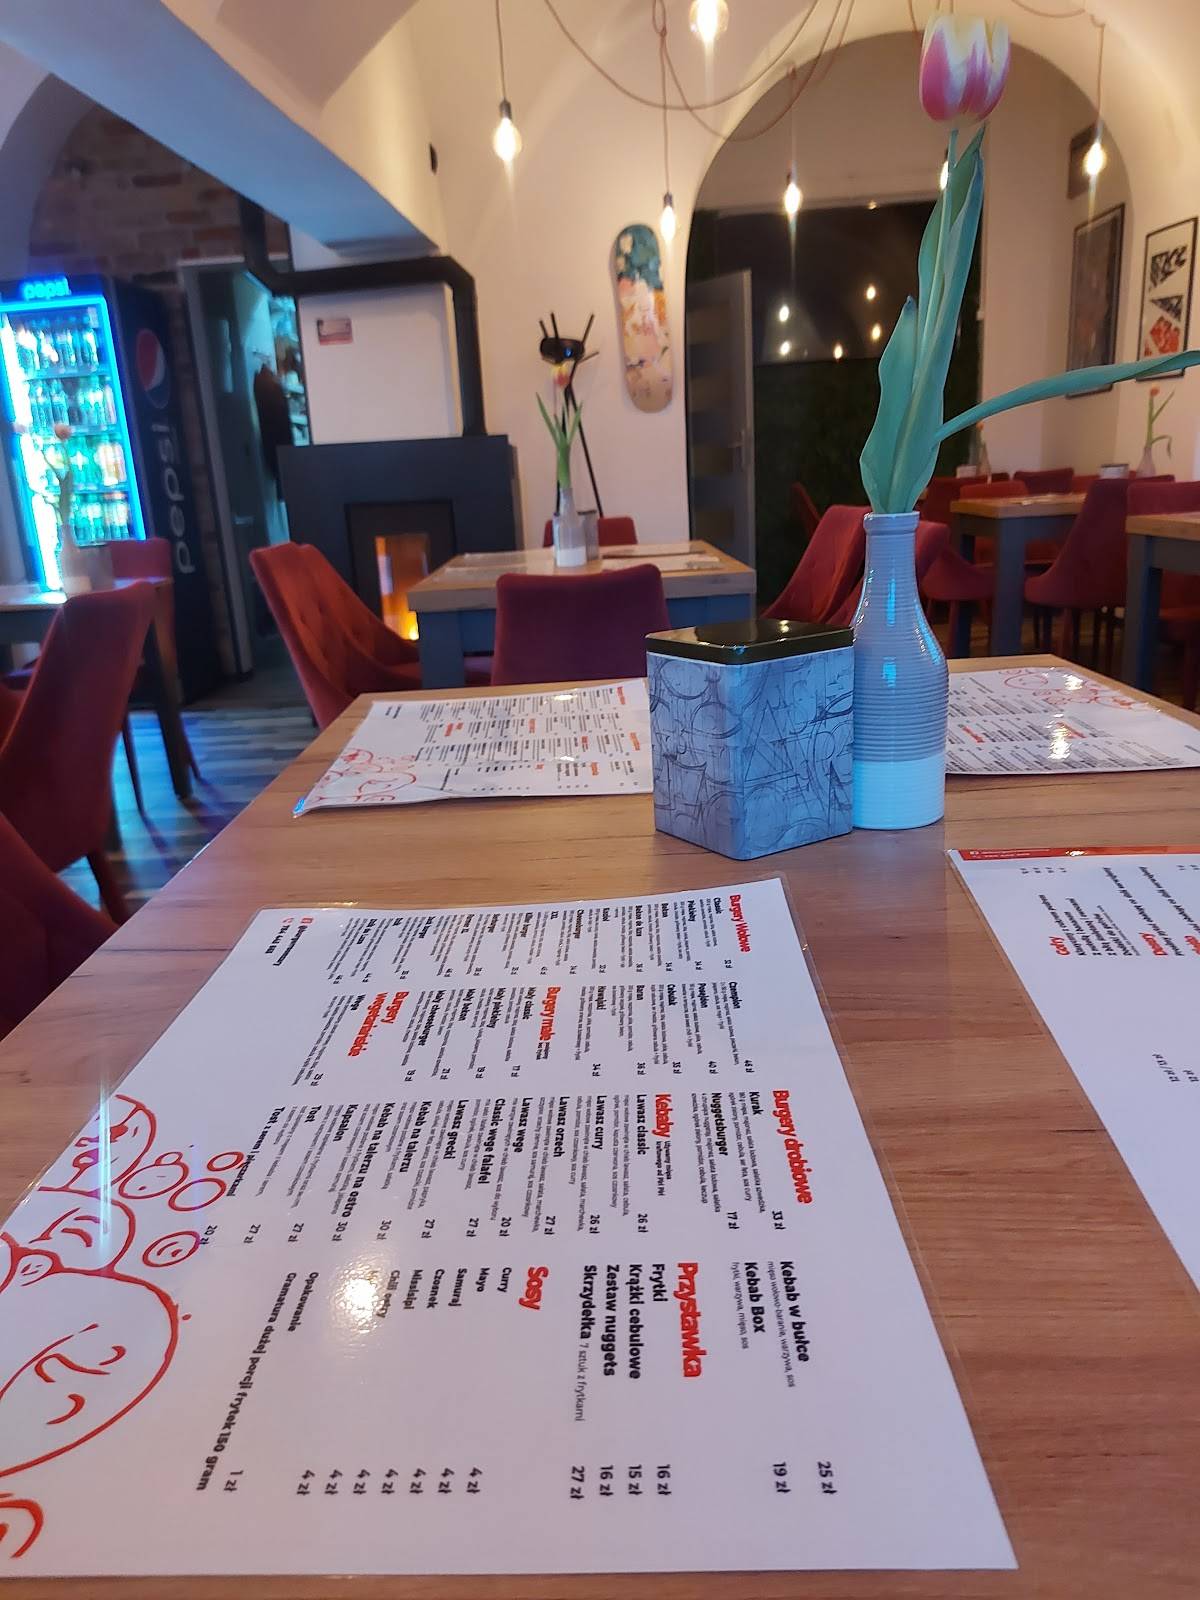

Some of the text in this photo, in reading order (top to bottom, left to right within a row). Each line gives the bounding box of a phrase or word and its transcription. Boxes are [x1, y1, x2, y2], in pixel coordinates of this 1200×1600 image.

[151, 424, 195, 574] pepsi
[380, 991, 409, 1024] Burgery
[303, 1105, 321, 1122] Tost
[651, 1093, 674, 1137] Kebaby
[748, 1091, 763, 1115] Kurak
[332, 1103, 358, 1141] Kapsalon
[398, 1100, 432, 1172] Kebab na talerzu
[442, 1099, 469, 1159] Lawasz grecki
[512, 1097, 533, 1152] Lawasz wege
[552, 1096, 569, 1157] Lawasz orzech
[590, 1095, 607, 1149] Lawasz curry
[636, 1094, 648, 1155] Lawasz classic
[709, 1092, 728, 1156] Nuggetsburger
[477, 1098, 505, 1184] Classic wege falafel
[772, 1090, 812, 1204] Burgery drobiowe
[341, 1102, 395, 1217] Kebab na talerzu na ostro
[248, 1224, 261, 1234] 27
[291, 1223, 304, 1232] 27
[335, 1221, 348, 1232] 30
[378, 1220, 391, 1231] 30
[424, 1219, 435, 1229] 27
[468, 1217, 479, 1227] 27
[500, 1216, 511, 1227] 20
[545, 1215, 555, 1225] 27
[589, 1214, 600, 1224] 26
[637, 1213, 647, 1223] 26
[726, 1211, 737, 1220] 17
[771, 1210, 783, 1220] 33
[474, 1267, 489, 1292] Mayo
[496, 1267, 511, 1292] Curry
[648, 1263, 668, 1301] Frytki
[730, 1261, 740, 1280] frytki,
[766, 1261, 776, 1280] mięso
[287, 1271, 318, 1332] Opakowanie
[402, 1269, 423, 1309] Missisipi
[426, 1268, 444, 1308] Czosnek
[447, 1268, 467, 1306] Samuraj
[518, 1266, 548, 1310] Sosy
[578, 1264, 597, 1339] Skrzydełka
[733, 1280, 743, 1311] warzywa,
[743, 1262, 765, 1332] Kebab Box
[600, 1264, 619, 1376] Zestaw nuggets
[624, 1264, 644, 1379] Krążki cebulowe
[672, 1262, 706, 1377] Przystawka
[736, 1312, 746, 1335] mięso,
[779, 1261, 809, 1362] Kebab w bułce
[576, 1350, 587, 1373] sztuk
[780, 1338, 792, 1373] warzywa,
[195, 1272, 296, 1490] Gramatura dużej porcji frytek 150 gram
[785, 1374, 795, 1387] sos
[573, 1381, 586, 1421] frytkami
[223, 1479, 236, 1492] zł
[296, 1470, 314, 1495] 4 zł
[324, 1469, 342, 1495] 4 zł
[352, 1469, 369, 1495] 4 zł
[380, 1468, 398, 1494] 4 zł
[409, 1468, 425, 1494] 4 zł
[437, 1468, 453, 1494] 4 zł
[465, 1467, 482, 1494] 4 zł
[569, 1466, 584, 1499] 27 zł
[599, 1465, 613, 1496] 16 zł
[627, 1464, 642, 1495] 15 zł
[656, 1464, 671, 1495] 16 zł
[772, 1462, 790, 1493] 19 zł
[817, 1461, 836, 1494] 25 zł
